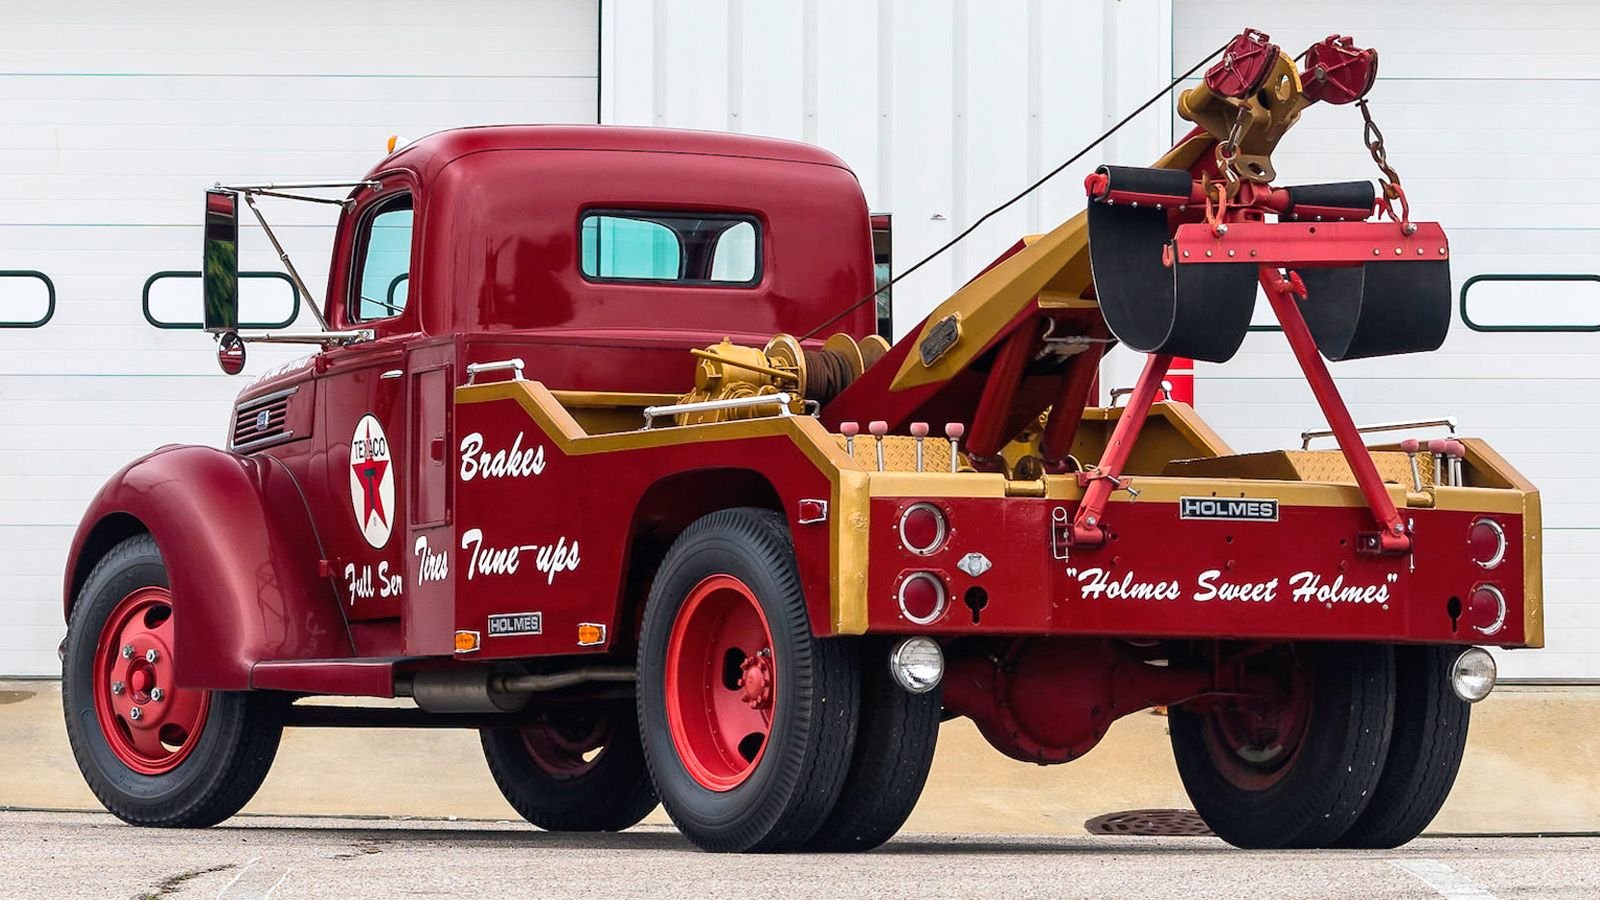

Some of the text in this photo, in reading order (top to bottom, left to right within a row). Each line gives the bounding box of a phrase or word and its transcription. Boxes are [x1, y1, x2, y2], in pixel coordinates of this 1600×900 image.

[354, 437, 386, 459] TEXACO
[460, 431, 546, 482] Brakes
[1185, 501, 1274, 517] HOLMES
[415, 535, 448, 586] Tires
[461, 528, 581, 585] Tune-ups
[345, 563, 375, 607] Full
[1193, 570, 1279, 602] Sweet
[490, 617, 539, 632] HOLMES
